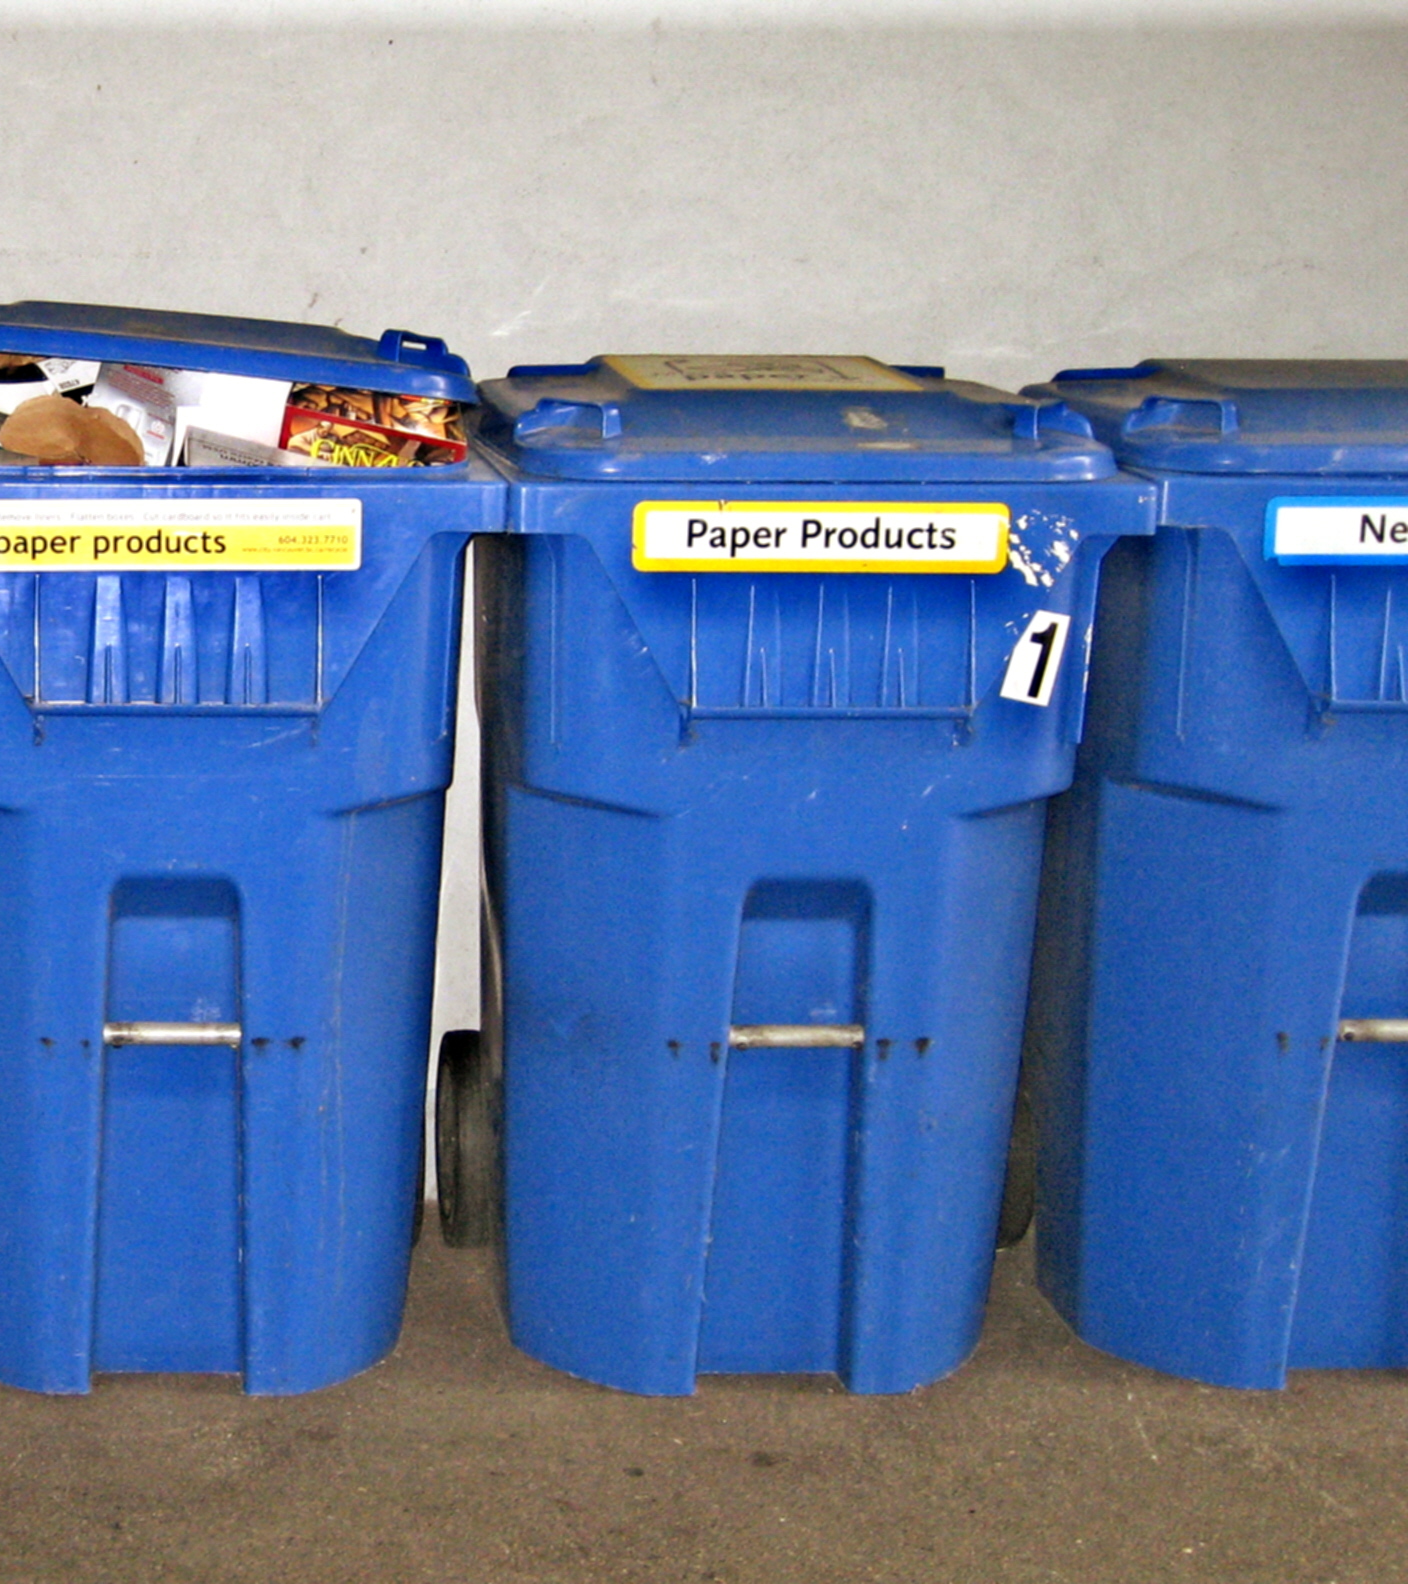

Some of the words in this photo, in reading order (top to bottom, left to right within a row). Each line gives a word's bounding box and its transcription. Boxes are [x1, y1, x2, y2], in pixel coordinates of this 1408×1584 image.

[93, 529, 227, 560] products
[687, 517, 787, 557] Paper
[801, 517, 956, 550] Products
[1026, 622, 1058, 698] 1
